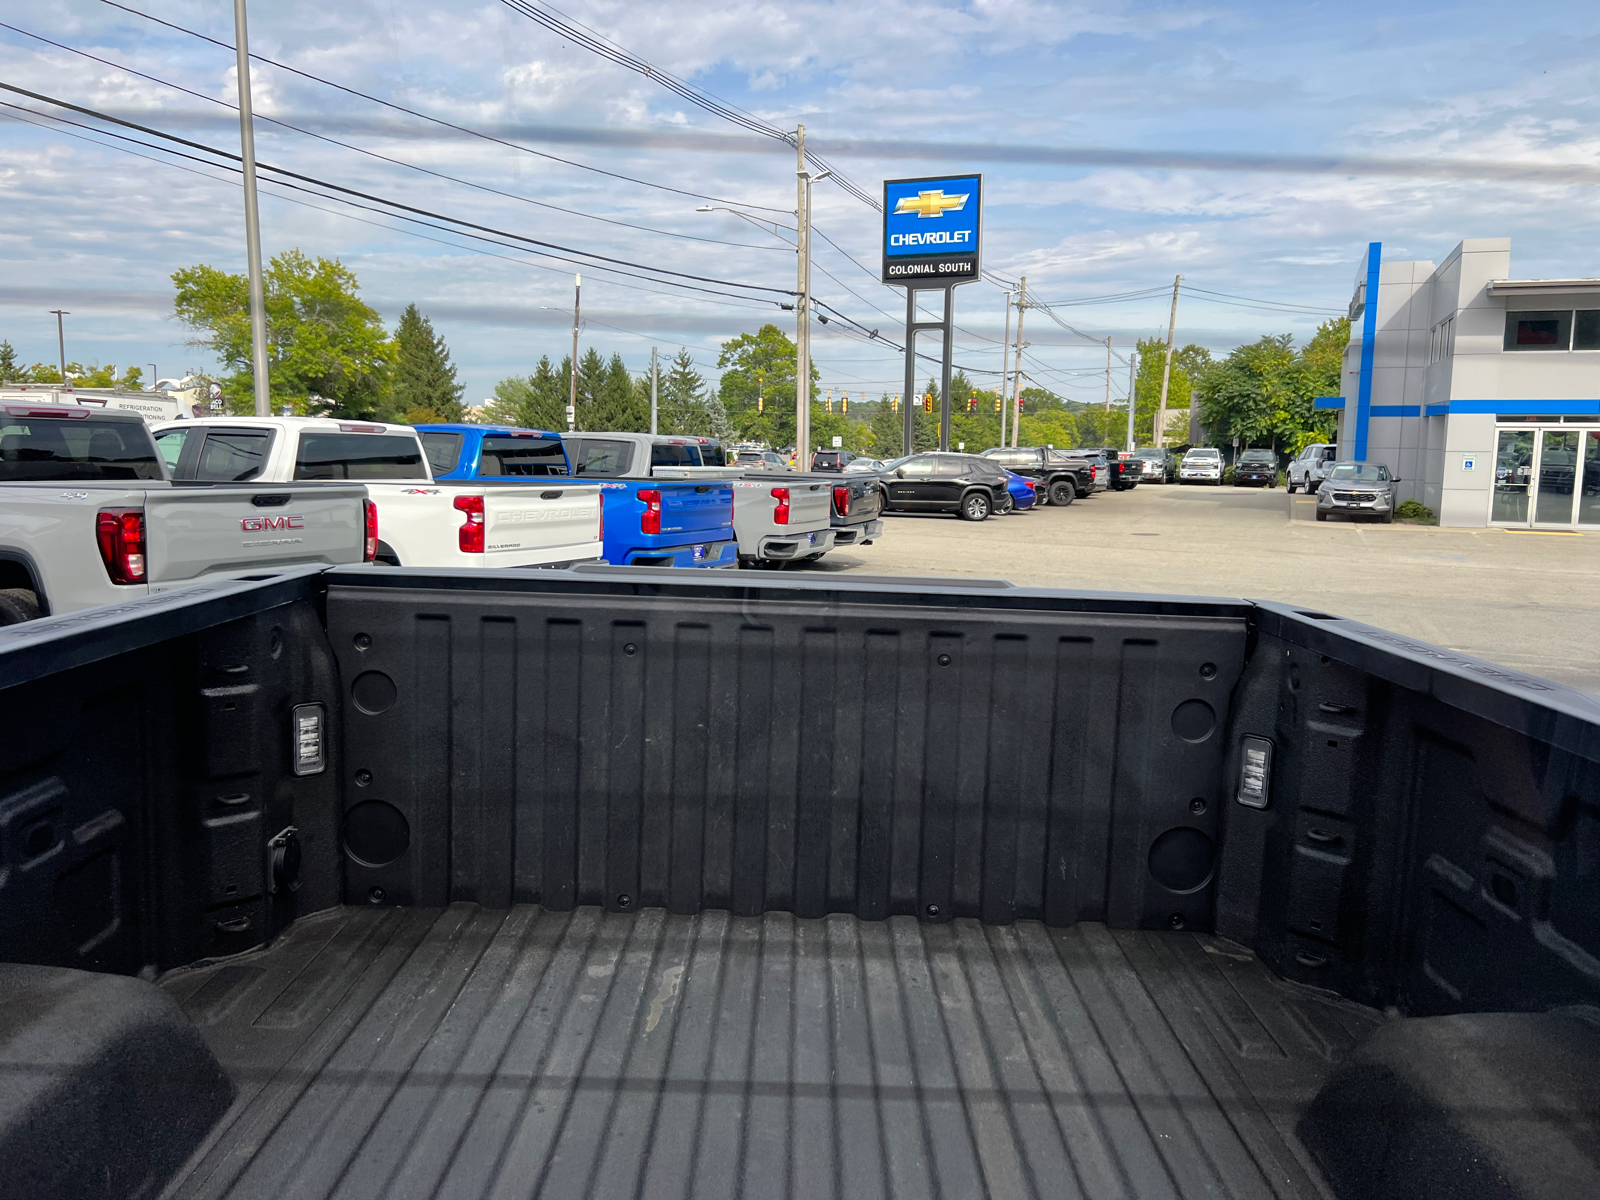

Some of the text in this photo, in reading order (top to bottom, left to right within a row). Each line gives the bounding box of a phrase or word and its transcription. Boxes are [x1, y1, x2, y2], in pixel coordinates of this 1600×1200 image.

[891, 230, 971, 246] CHEVROLET
[889, 262, 971, 275] COLONIAL SOUTH
[119, 404, 163, 412] REFRIGERATION
[497, 507, 596, 523] CHEVROLET
[241, 515, 304, 532] GMC
[242, 538, 303, 548] SIERRA
